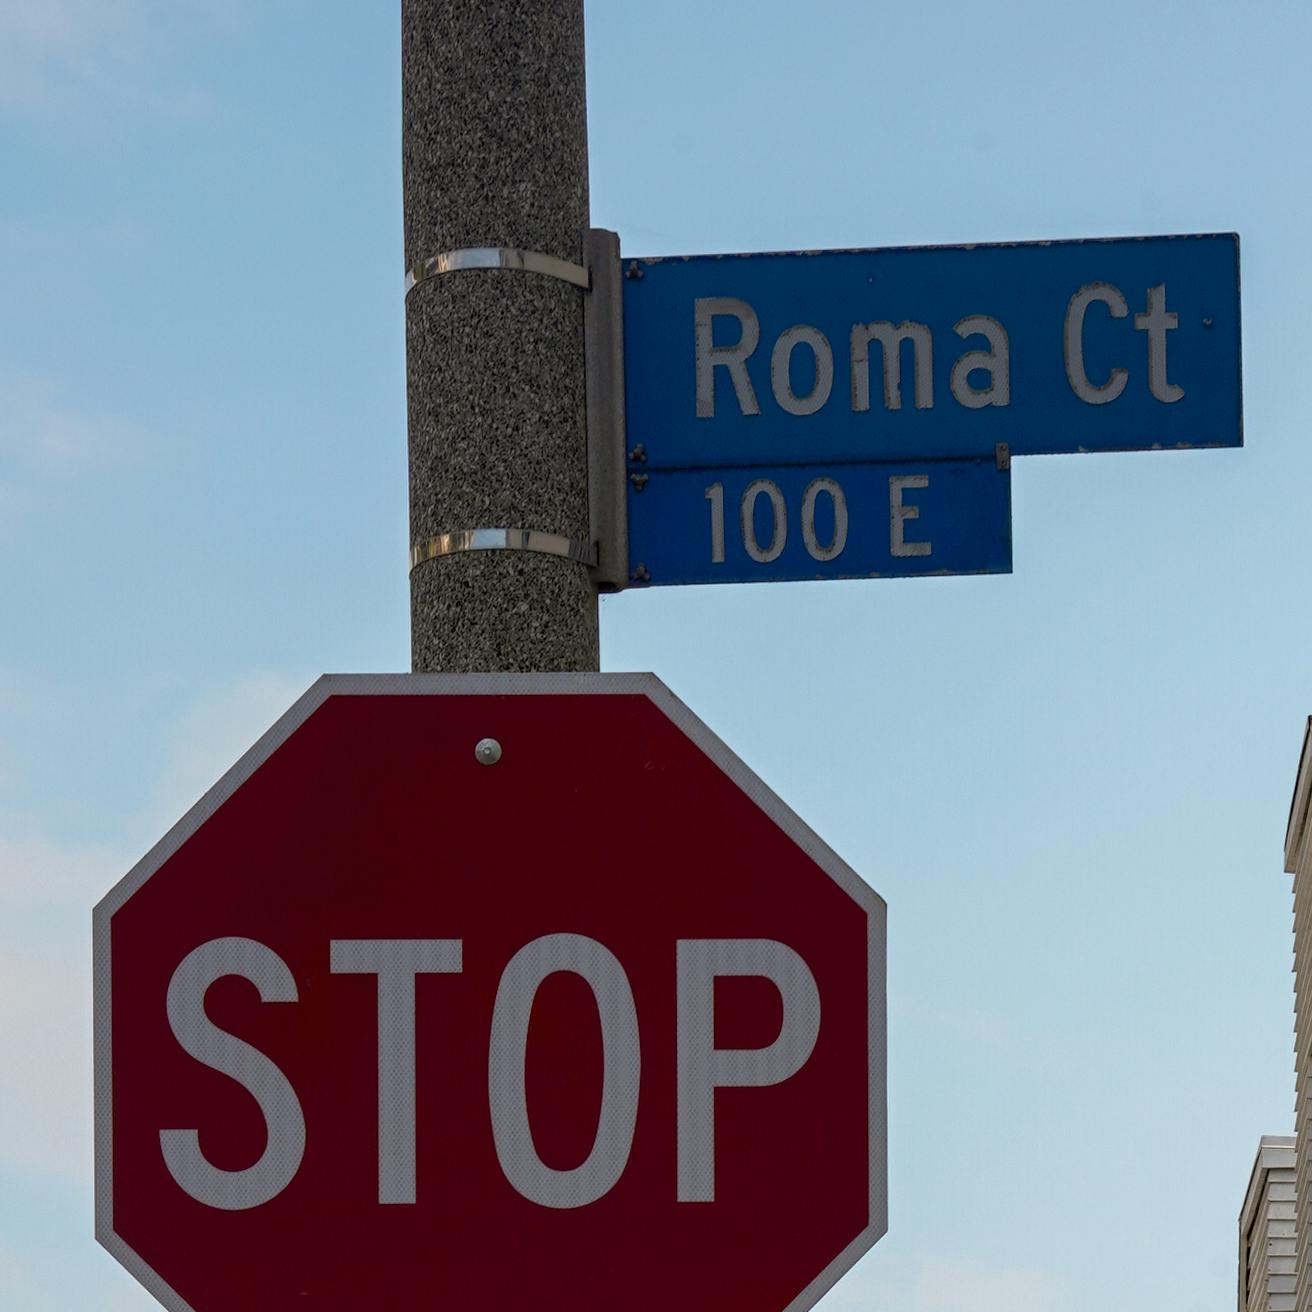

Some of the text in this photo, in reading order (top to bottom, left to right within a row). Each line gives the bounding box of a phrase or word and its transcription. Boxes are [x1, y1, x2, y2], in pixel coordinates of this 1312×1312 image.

[694, 283, 1185, 418] Roma Ct
[705, 475, 932, 563] 100 E
[159, 933, 821, 1210] STOP
